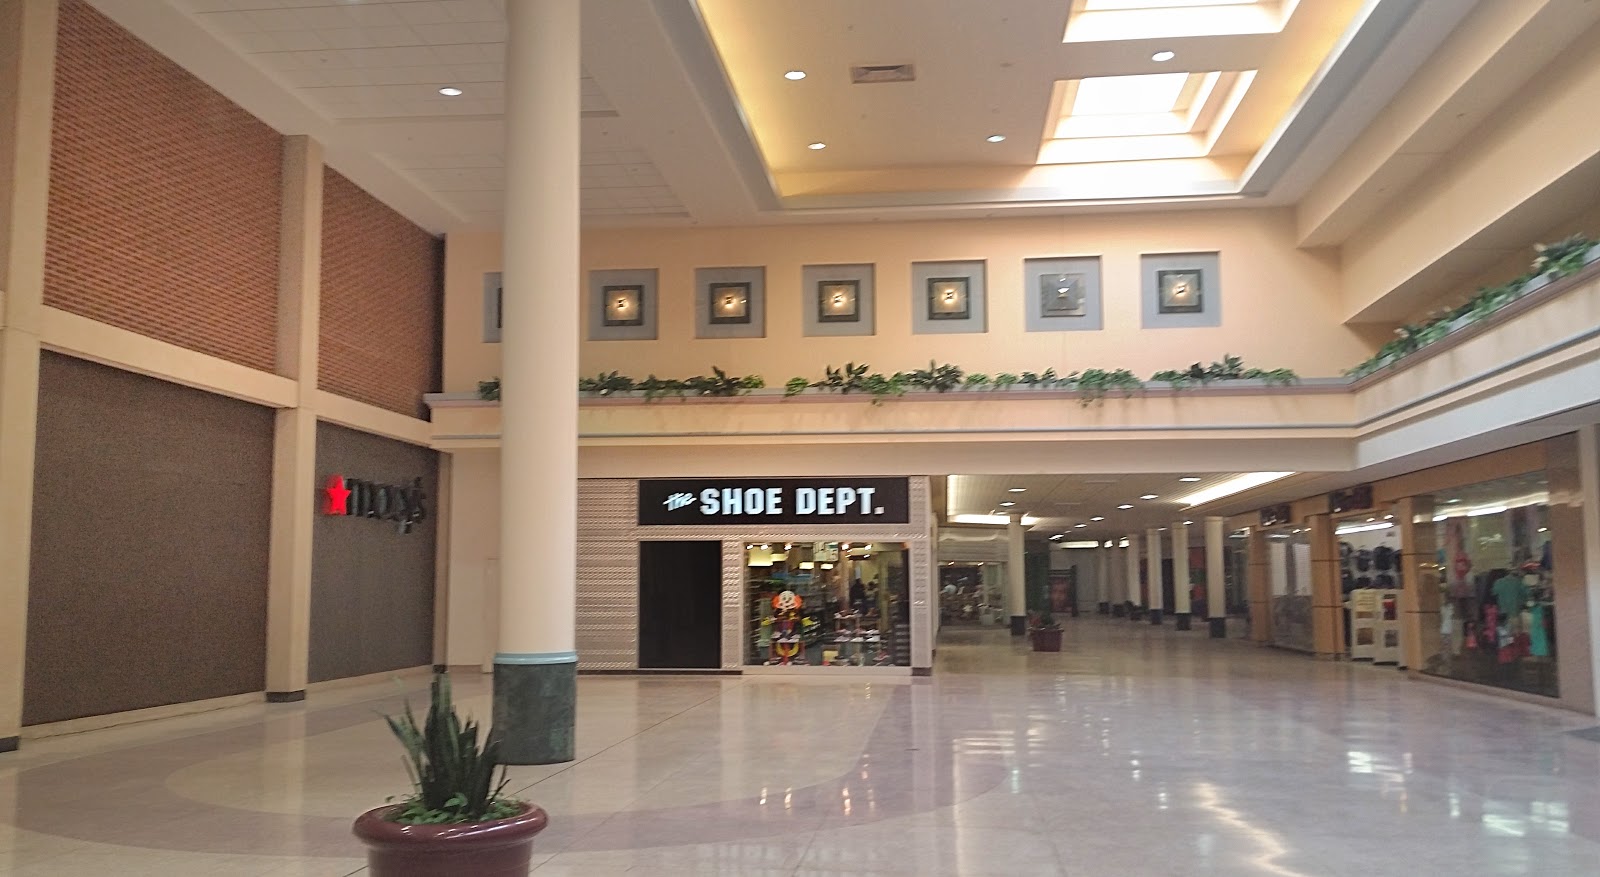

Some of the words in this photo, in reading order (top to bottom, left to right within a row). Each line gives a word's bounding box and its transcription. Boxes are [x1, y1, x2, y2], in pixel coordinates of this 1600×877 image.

[662, 492, 697, 511] the
[700, 487, 783, 515] SHOE
[795, 487, 885, 515] DEPT.
